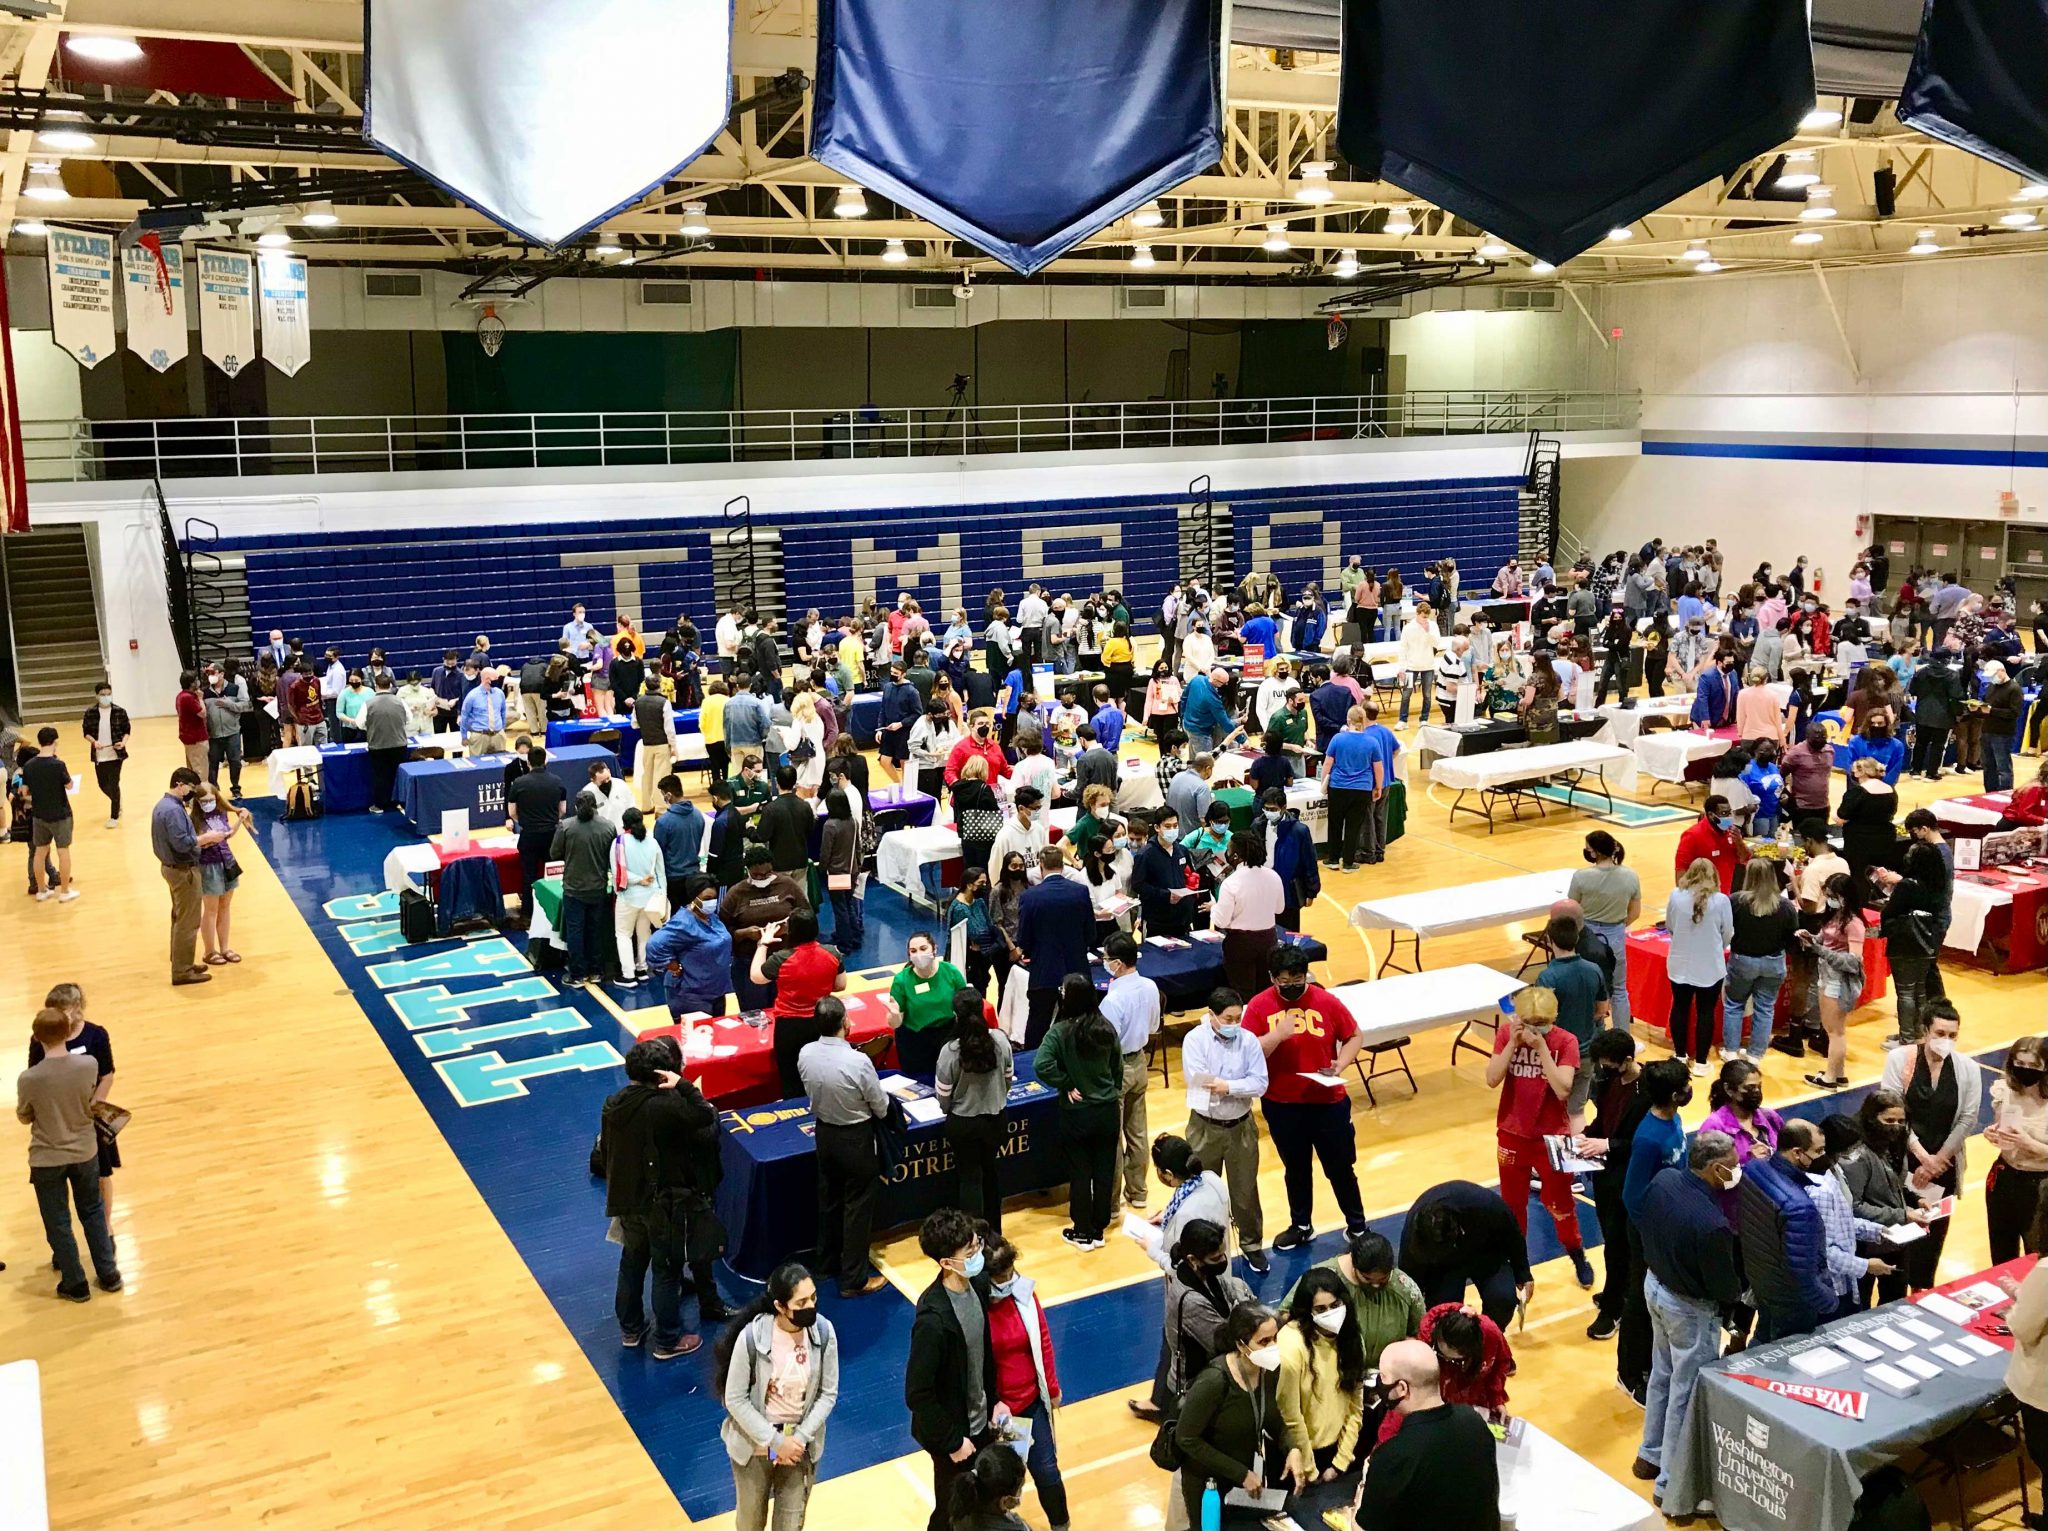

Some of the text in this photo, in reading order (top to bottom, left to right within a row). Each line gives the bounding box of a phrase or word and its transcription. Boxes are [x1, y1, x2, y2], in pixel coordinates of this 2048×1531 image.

[52, 231, 110, 259] TITANS
[478, 782, 505, 790] UNIV
[1509, 1063, 1547, 1079] CORP
[1007, 1119, 1029, 1134] OF
[1712, 1421, 1794, 1490] Washington
[1718, 1446, 1788, 1504] University
[1718, 1466, 1732, 1489] in
[1752, 1484, 1786, 1520] Louis
